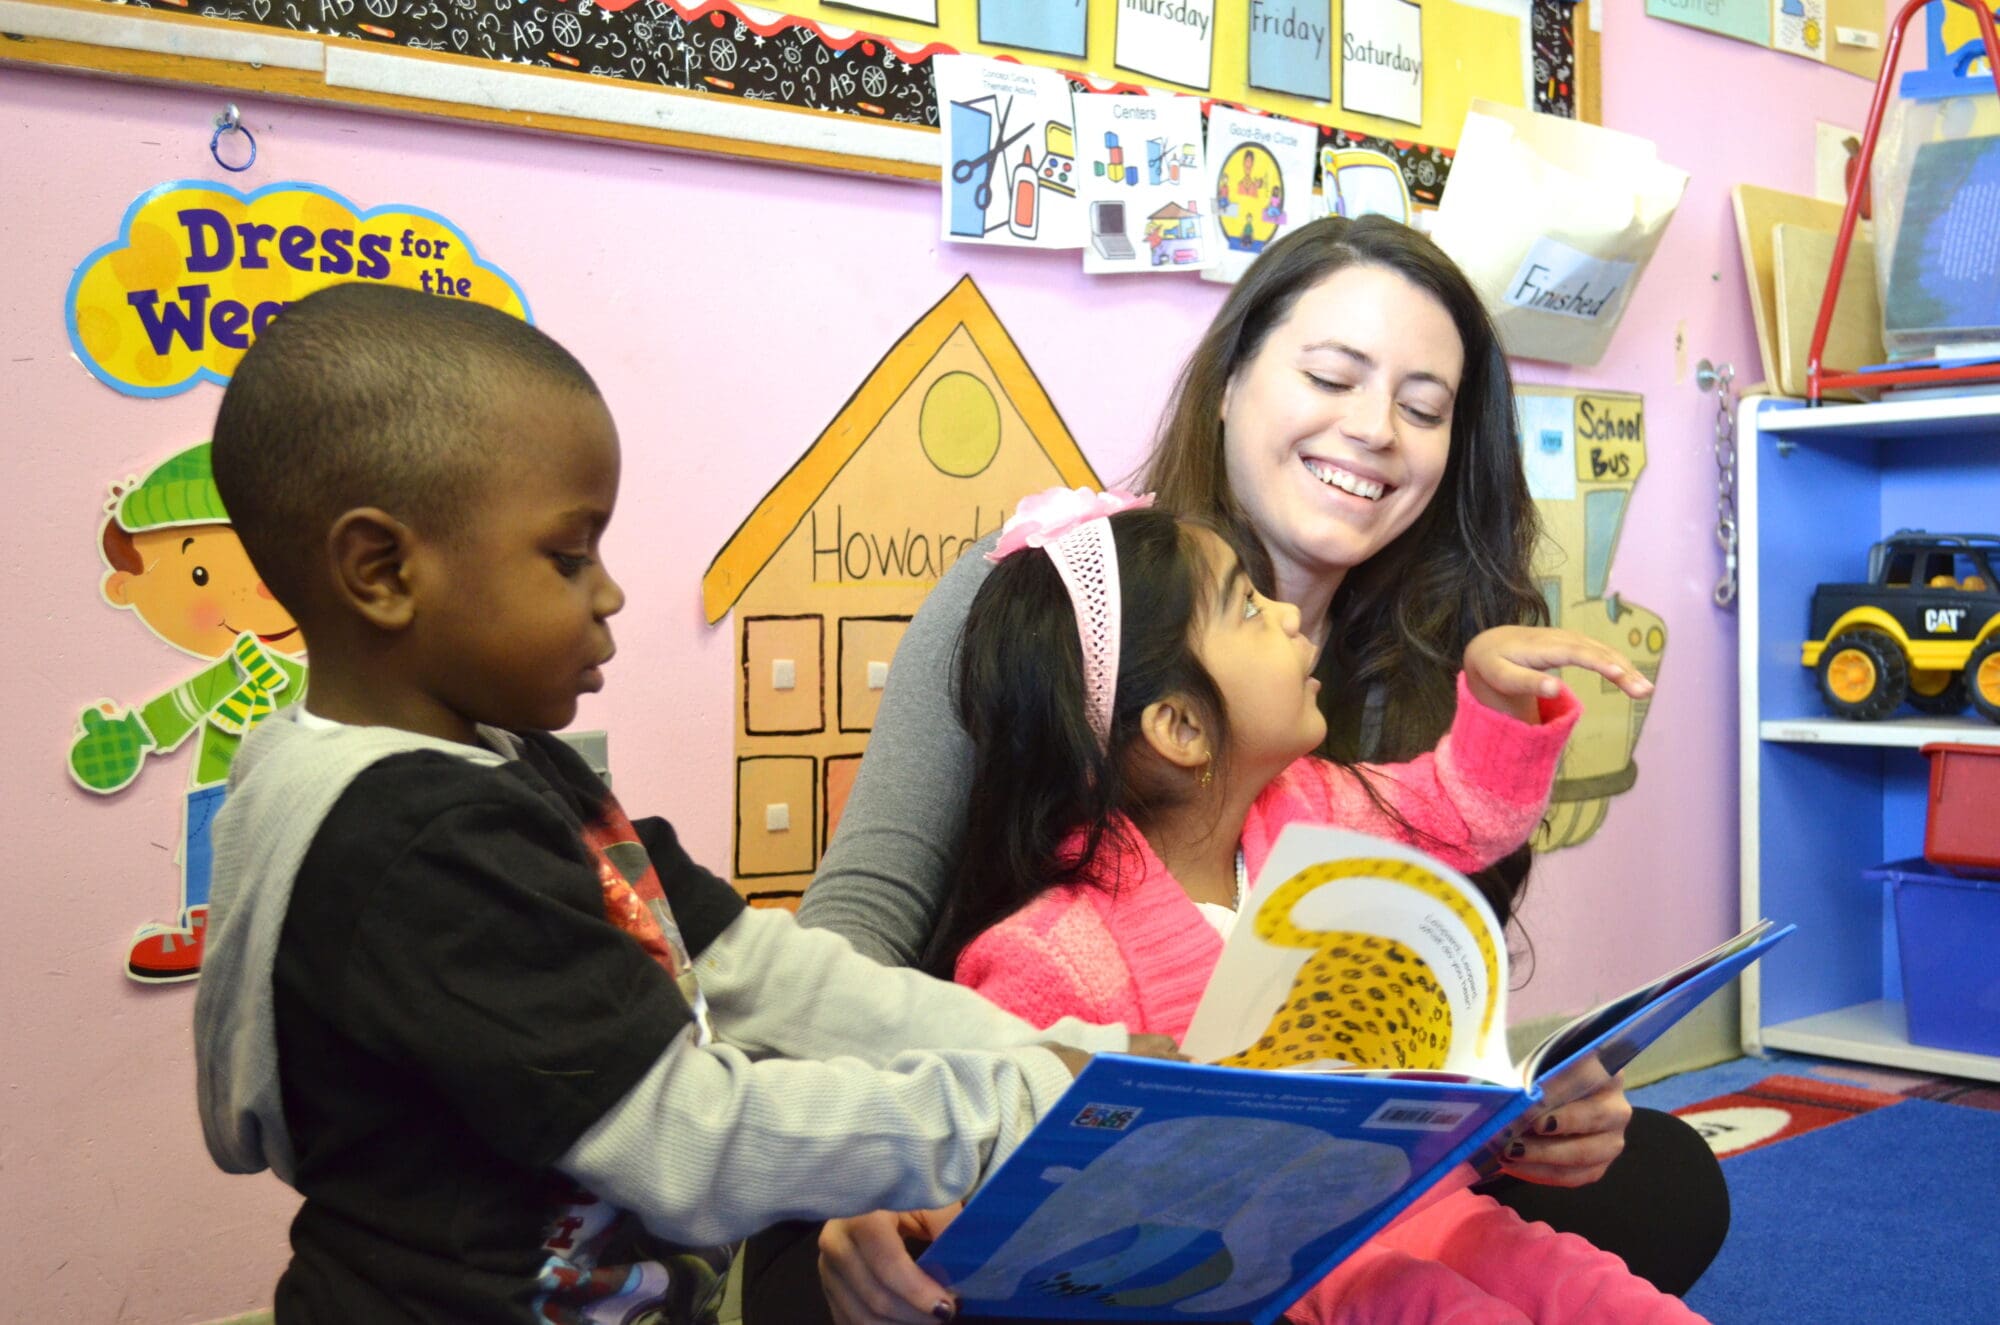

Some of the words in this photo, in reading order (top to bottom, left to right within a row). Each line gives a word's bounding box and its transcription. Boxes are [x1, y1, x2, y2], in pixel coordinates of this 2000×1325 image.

[1126, 0, 1210, 41] ursday
[1252, 0, 1325, 60] Friday
[1343, 33, 1421, 86] Saturday
[1113, 104, 1156, 120] Centers
[1230, 122, 1271, 143] Good-Bye
[1273, 131, 1299, 147] Circle
[176, 208, 392, 280] Dress
[400, 229, 450, 261] for
[420, 268, 472, 298] the
[1514, 263, 1617, 317] Finished
[1578, 400, 1641, 442] School
[812, 504, 980, 583] Howard
